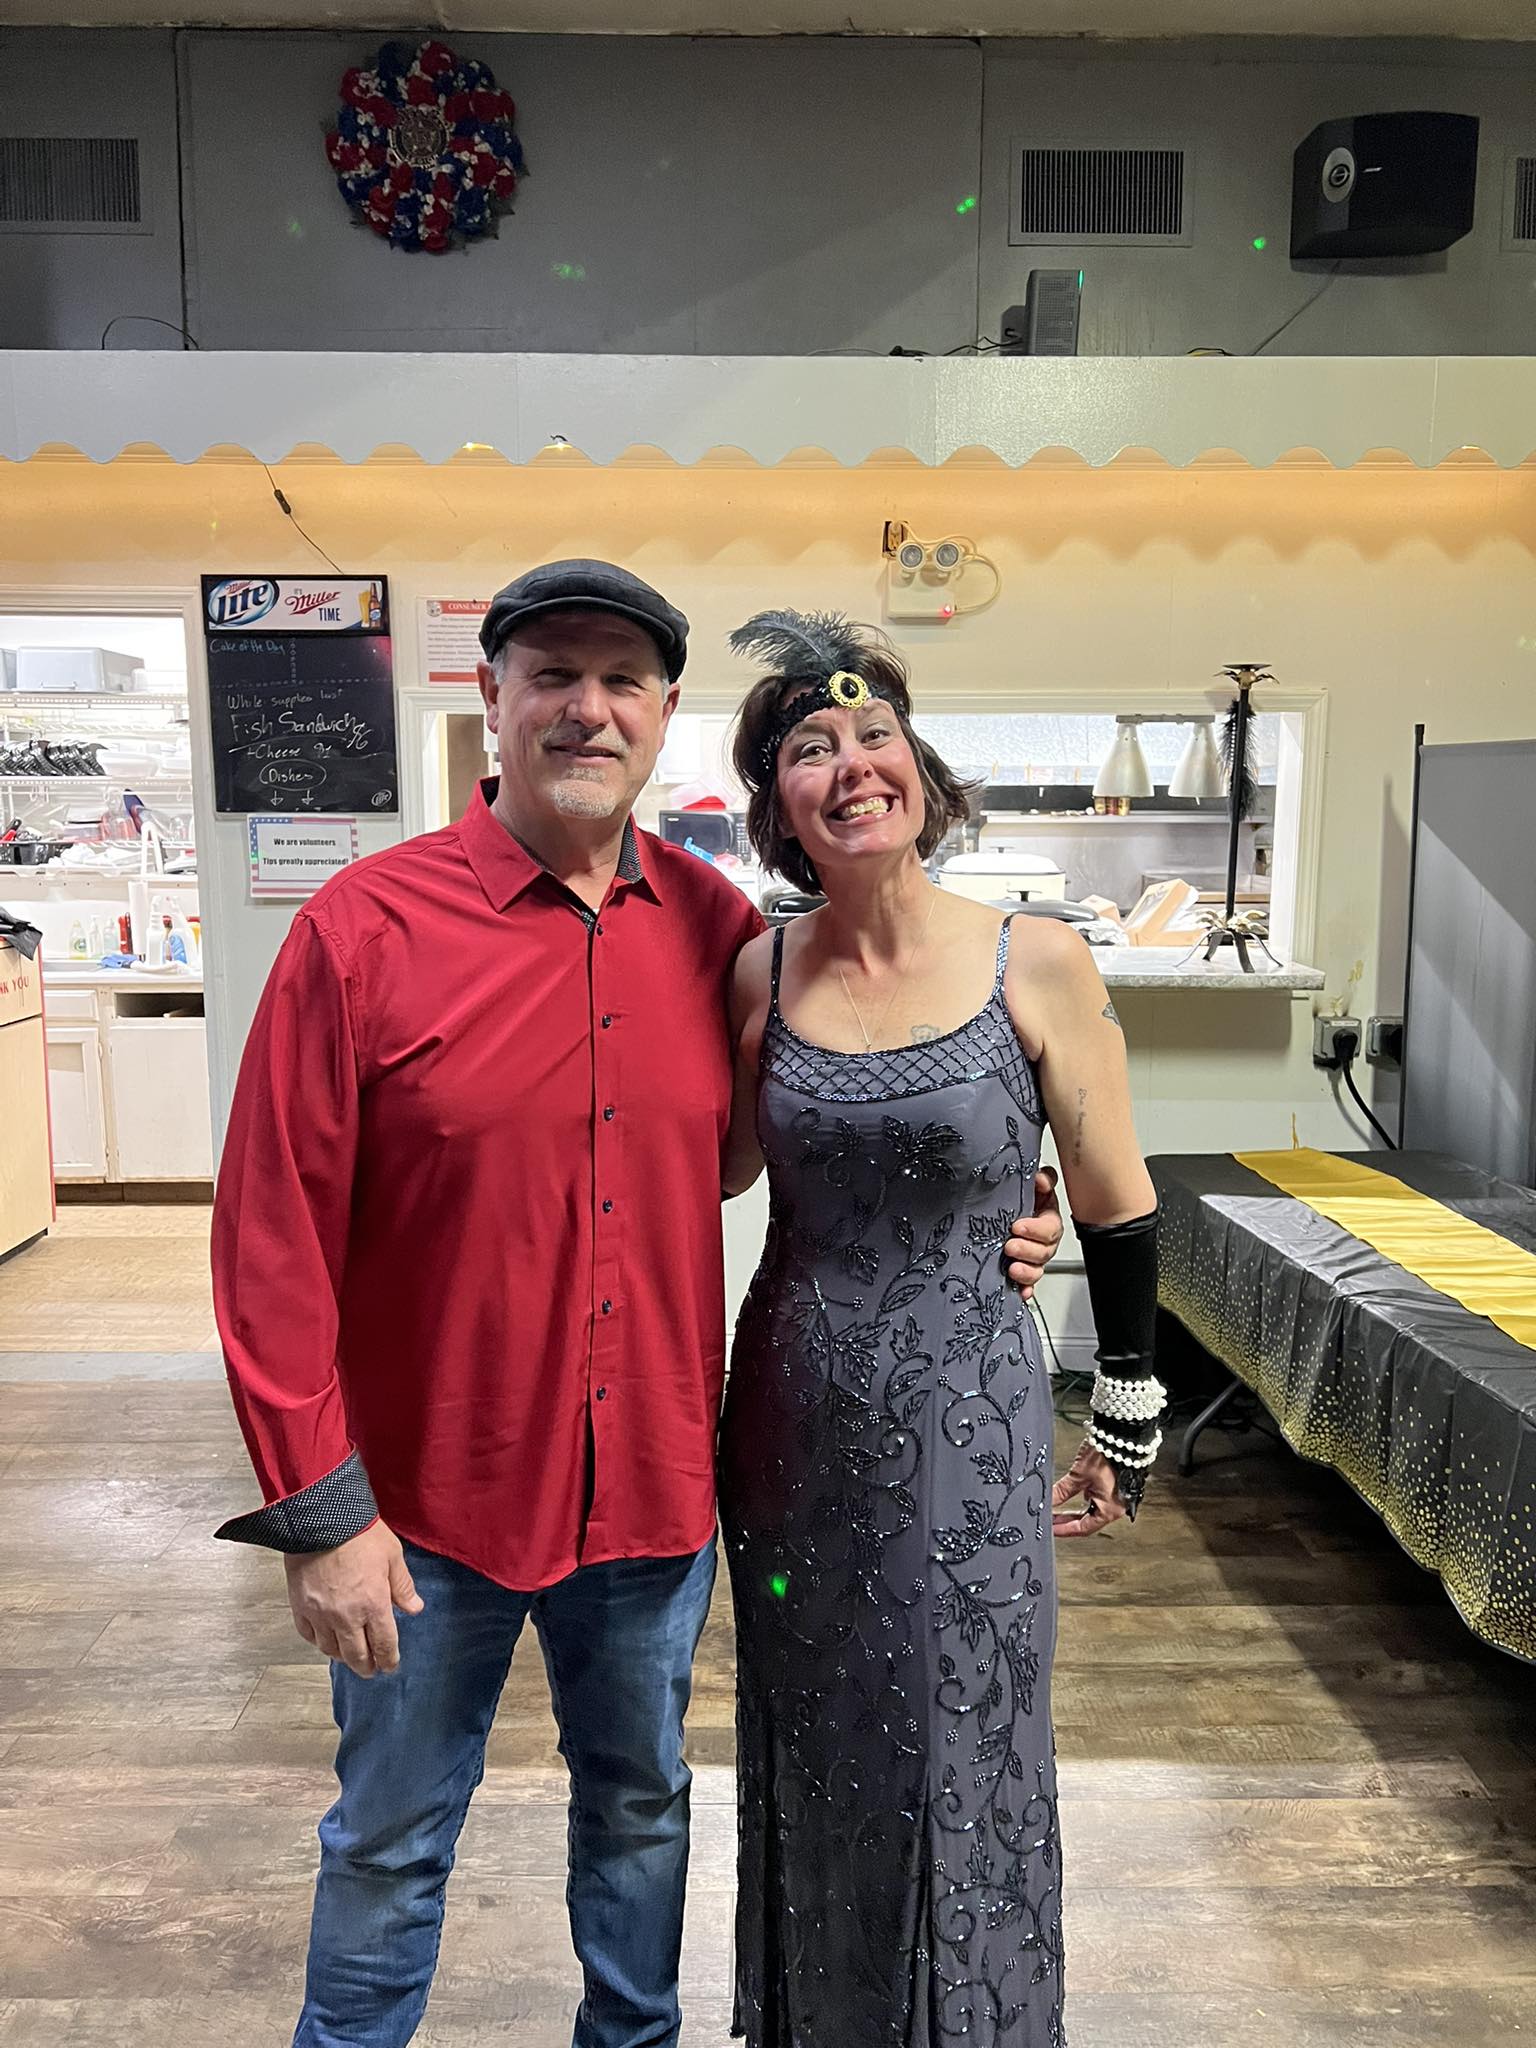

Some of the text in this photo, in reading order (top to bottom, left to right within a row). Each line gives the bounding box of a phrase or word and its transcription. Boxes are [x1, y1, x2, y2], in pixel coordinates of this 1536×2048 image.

[284, 591, 341, 614] Miller
[318, 607, 342, 622] TIME
[230, 712, 273, 742] Fish
[273, 838, 285, 846] We
[299, 838, 337, 846] volunteers
[263, 857, 278, 866] Tips
[279, 857, 303, 866] greatly
[12, 975, 29, 991] YOU
